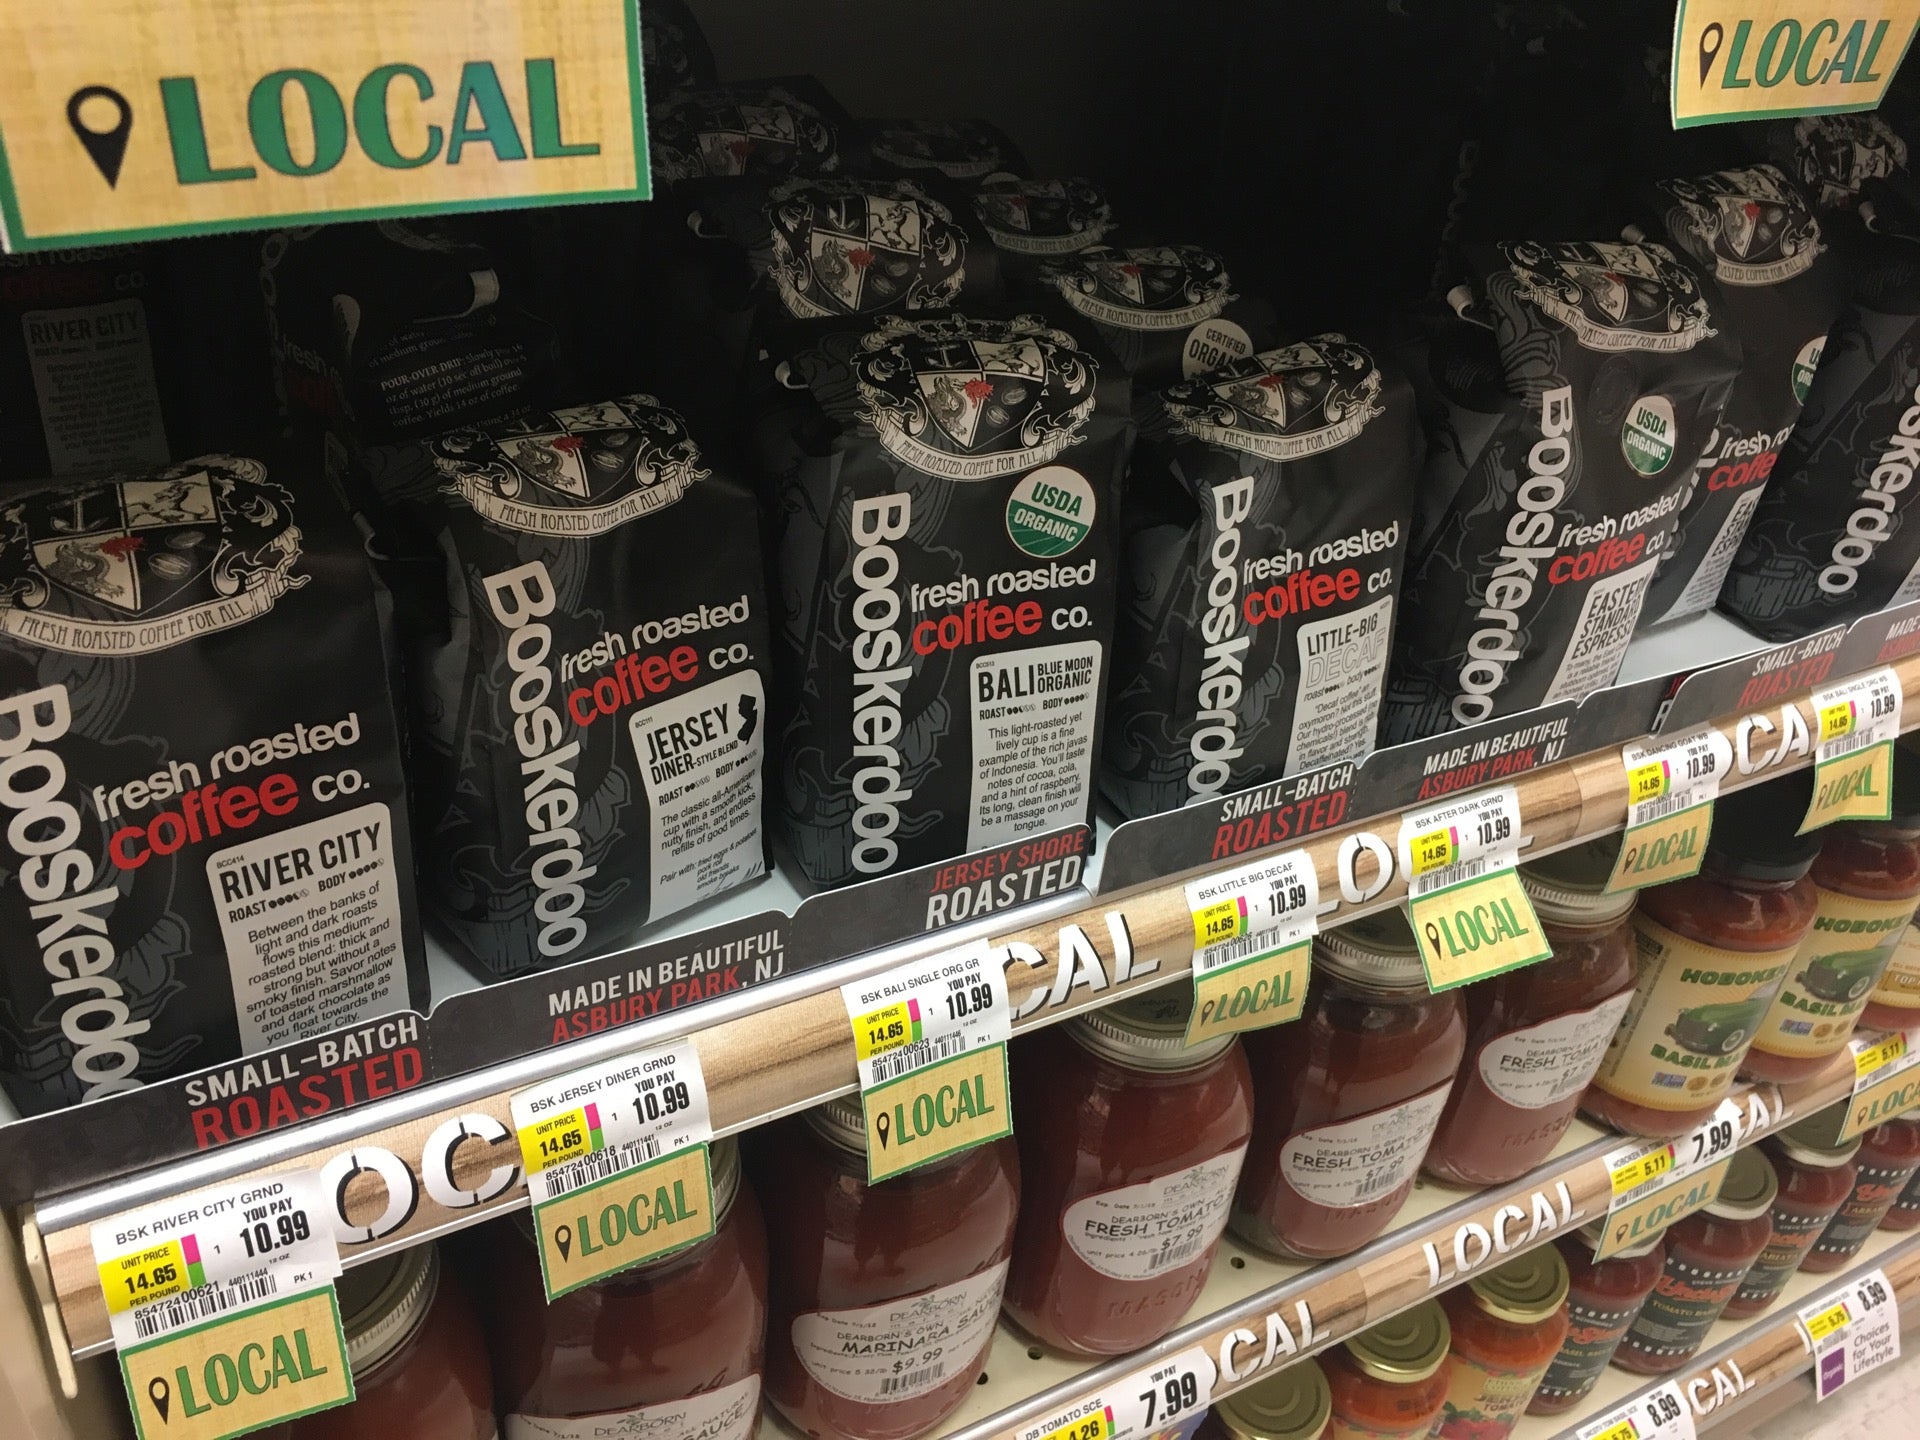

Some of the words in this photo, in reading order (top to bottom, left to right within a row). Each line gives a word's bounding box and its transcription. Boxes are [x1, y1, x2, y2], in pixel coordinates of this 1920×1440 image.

[1722, 19, 1890, 89] LOCAL
[160, 58, 600, 185] LOCAL
[30, 318, 92, 344] RIVER
[95, 311, 139, 336] CITY
[1206, 328, 1246, 354] CERTIFIED
[1626, 432, 1667, 462] ORGANIC
[1635, 406, 1666, 438] USDA
[900, 441, 922, 461] FRESH
[922, 454, 962, 475] ROASTED
[964, 459, 993, 476] COFFEE
[996, 456, 1015, 472] FOR
[1019, 450, 1039, 467] ALL
[1013, 508, 1078, 544] ORGANIC
[1031, 481, 1082, 517] USDA
[1557, 515, 1617, 549] fresh
[1619, 486, 1683, 537] roasted
[1243, 549, 1303, 585] fresh
[1308, 520, 1399, 565] roasted
[1452, 384, 1572, 725] Booskerdoo
[1547, 532, 1645, 585] coffee
[911, 573, 979, 613] fresh
[986, 559, 1097, 597] roasted
[1243, 568, 1361, 626] coffee
[1367, 567, 1392, 593] co.
[18, 614, 67, 645] FRESH
[72, 628, 136, 650] ROASTED
[139, 618, 186, 645] COFFEE
[188, 609, 215, 632] FOR
[219, 599, 250, 623] ALL
[561, 631, 624, 683] fresh
[631, 595, 750, 651] roasted
[912, 600, 1043, 656] coffee
[1051, 606, 1093, 631] co.
[1187, 476, 1255, 807] Booskerdo
[1307, 612, 1378, 657] LITTLE-BIG
[1751, 629, 1846, 677] SMALL-BATCH
[567, 644, 699, 727] coffee
[708, 643, 754, 671] co.
[851, 491, 914, 873] Booskerdoo
[978, 664, 1035, 703] BALI
[1038, 661, 1063, 676] BLUE
[1065, 656, 1093, 672] MOON
[1038, 669, 1092, 693] ORGANIC
[1306, 627, 1386, 688] DECAF
[1736, 652, 1836, 709] ROASTED
[646, 702, 729, 765] JERSEY
[980, 706, 1006, 720] ROAST
[1043, 697, 1064, 710] BODY
[988, 728, 1009, 739] This
[1011, 714, 1067, 737] light-roasted
[1069, 712, 1082, 724] yet
[1870, 693, 1896, 719] 10.99
[93, 760, 201, 822] fresh
[210, 712, 361, 779] roasted
[482, 560, 598, 957] Booskerdoo
[650, 749, 718, 785] DINER-STYLE
[718, 740, 739, 756] BLEND
[1417, 763, 1488, 801] ASBURY
[1491, 747, 1539, 778] PARK,
[1542, 740, 1565, 760] NJ
[1423, 749, 1469, 776] MADE
[1472, 743, 1489, 762] IN
[1488, 720, 1568, 757] BEAUTIFUL
[1638, 776, 1661, 794] 14.65
[1686, 752, 1716, 780] 10.99
[658, 785, 683, 806] ROAST
[715, 761, 734, 779] BODY
[1219, 764, 1354, 823] SMALL-BATCH
[1415, 817, 1432, 829] BSK
[1433, 808, 1458, 825] AFTER
[1459, 802, 1481, 816] DARK
[1481, 794, 1503, 808] GRND
[1822, 763, 1879, 810] LOCAL
[109, 772, 299, 870] coffee
[311, 769, 371, 802] co.
[1211, 790, 1349, 860] ROASTED
[1422, 843, 1447, 863] 14.65
[1477, 816, 1511, 847] 10.99
[219, 847, 314, 903] RIVER
[318, 821, 381, 870] CITY
[930, 853, 1009, 894] JERSEY
[1016, 831, 1087, 870] SHORE
[1632, 825, 1698, 874] LOCAL
[0, 684, 152, 1103] Booskerdo
[228, 900, 267, 923] ROAST
[318, 872, 347, 892] BODY
[248, 915, 305, 943] Between
[307, 905, 327, 921] the
[330, 890, 367, 912] banks
[369, 881, 380, 896] of
[925, 856, 1083, 930] ROASTED
[1206, 915, 1234, 937] 14.65
[1268, 883, 1307, 917] 10.99
[255, 936, 283, 955] light
[285, 926, 309, 944] and
[311, 917, 339, 936] dark
[342, 900, 378, 919] roasts
[1438, 897, 1530, 958] LOCAL
[548, 975, 624, 1018] MADE
[628, 968, 654, 996] IN
[658, 929, 785, 987] BEAUTIFUL
[1001, 912, 1160, 1023] CAL
[551, 989, 663, 1044] ASBURY
[671, 966, 749, 1014] PARK,
[754, 951, 786, 983] NJ
[868, 1021, 904, 1045] 14.65
[946, 982, 994, 1021] 10.99
[1212, 970, 1295, 1024] LOCAL
[184, 1015, 419, 1108] SMALL-BATCH
[530, 1098, 556, 1113] BSK
[558, 1079, 603, 1104] JERSEY
[605, 1066, 641, 1087] DINER
[643, 1054, 676, 1073] GRND
[1650, 1043, 1712, 1070] BASIL
[191, 1047, 424, 1150] ROASTED
[539, 1129, 583, 1157] 14.65
[632, 1081, 691, 1125] 10.99
[894, 1074, 995, 1146] LOCAL
[1644, 1155, 1667, 1177] 5.11
[1692, 1120, 1733, 1164] 7.99
[115, 1225, 148, 1246] BSK
[152, 1209, 200, 1234] RIVER
[203, 1197, 236, 1217] CITY
[240, 1183, 285, 1205] GRND
[243, 1205, 269, 1224] YOU
[270, 1197, 293, 1216] PAY
[577, 1179, 698, 1257] LOCAL
[1085, 1219, 1149, 1237] FRESH
[1156, 1194, 1226, 1232] TOMATO
[1422, 1180, 1587, 1289] LOCAL
[1629, 1179, 1712, 1239] LOCAL
[121, 1255, 142, 1271] UNIT
[143, 1246, 170, 1265] PRICE
[124, 1263, 177, 1294] 14.65
[239, 1209, 311, 1259] 10.99
[1857, 1281, 1888, 1312] 8.99
[841, 1326, 950, 1355] MARINARA
[892, 1347, 943, 1375] $9.99
[1219, 1299, 1333, 1384] CAL
[1852, 1348, 1867, 1361] for
[1869, 1334, 1892, 1350] Your
[1853, 1322, 1890, 1348] Choices
[1853, 1346, 1894, 1375] Lifestyle
[175, 1328, 329, 1419] LOCAL
[1139, 1371, 1198, 1430] 7.99
[1041, 1405, 1082, 1435] TOMATO
[1083, 1398, 1104, 1414] SCE
